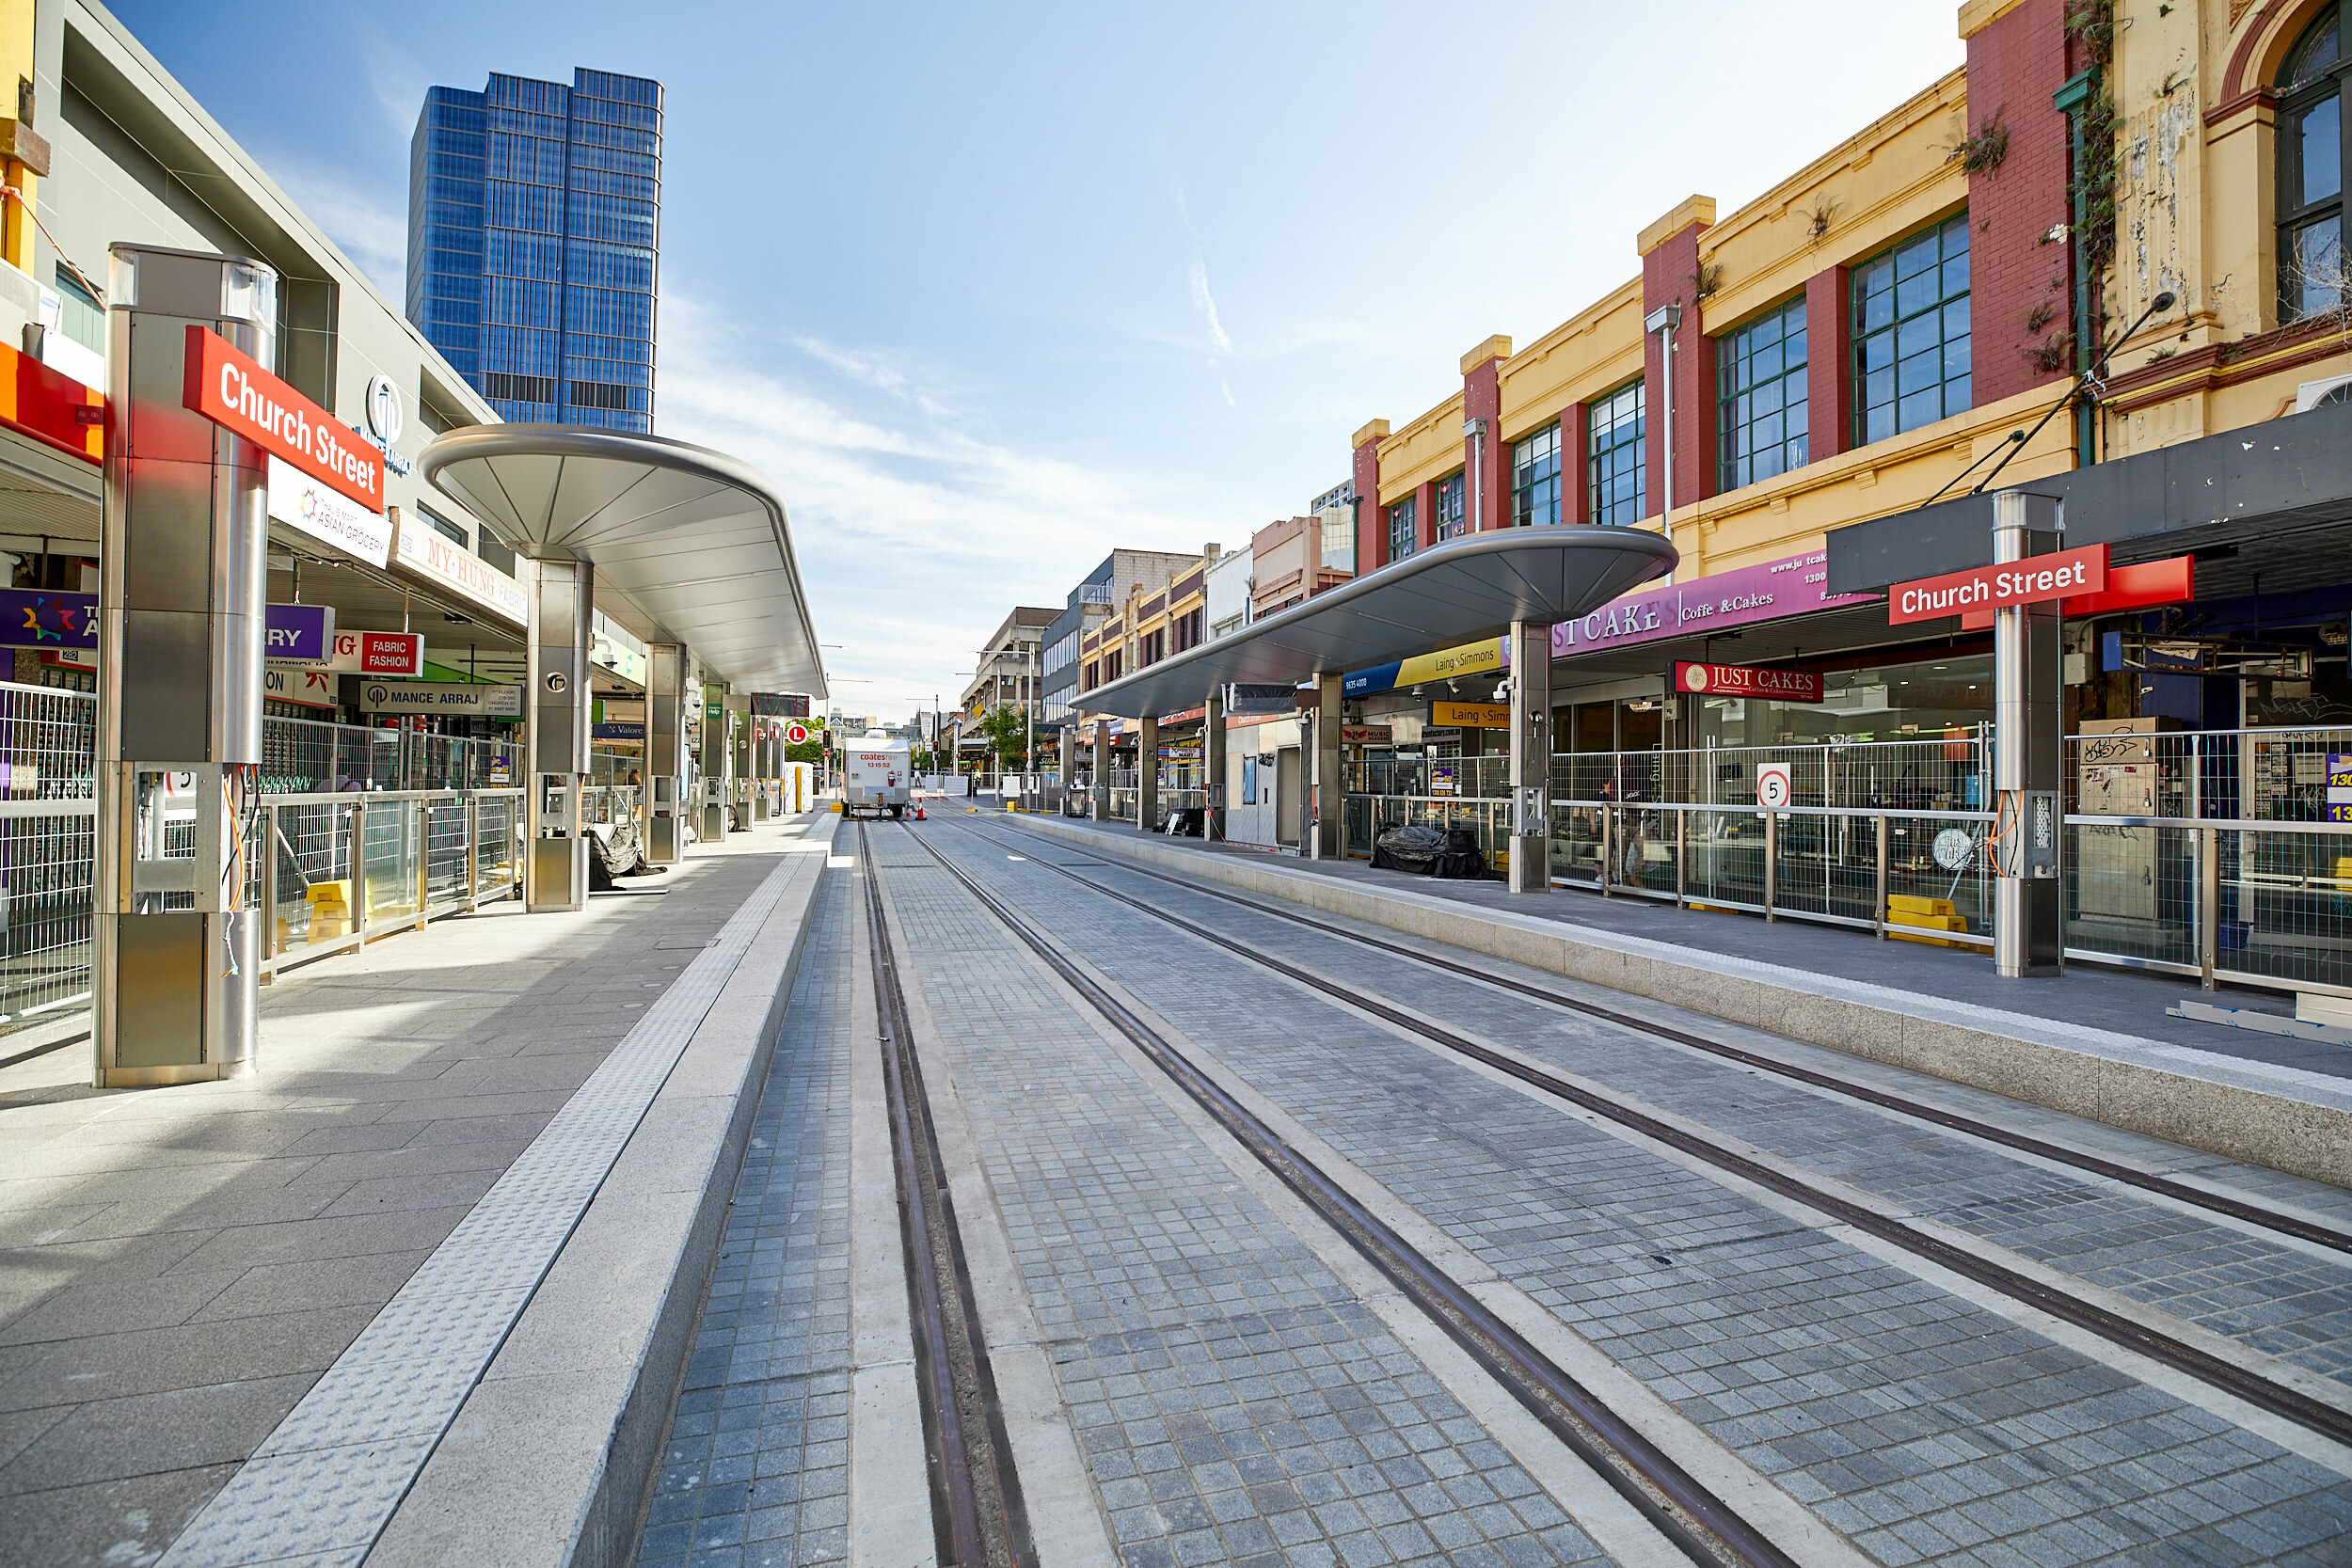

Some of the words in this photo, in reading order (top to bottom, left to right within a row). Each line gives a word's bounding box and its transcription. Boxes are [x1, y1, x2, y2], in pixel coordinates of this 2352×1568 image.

[221, 362, 311, 455] Church
[315, 424, 375, 495] Street
[317, 511, 344, 536] ASIAN
[345, 524, 385, 556] GROCERY
[1804, 571, 1826, 584] 1300
[1901, 577, 1989, 614] Church
[1995, 561, 2086, 598] Street
[63, 650, 78, 660] 282
[373, 641, 406, 654] FABRIC
[369, 655, 409, 668] FASHION
[1436, 657, 1454, 672] Laing
[1459, 650, 1494, 666] Simmons
[1712, 666, 1753, 688] JUST
[1757, 670, 1814, 691] CAKES
[390, 691, 434, 704] MANCE
[439, 693, 479, 705] ARRAJ
[1452, 707, 1479, 723] Laing
[617, 725, 644, 734] Valore
[793, 728, 802, 740] L
[1769, 782, 1778, 800] 5
